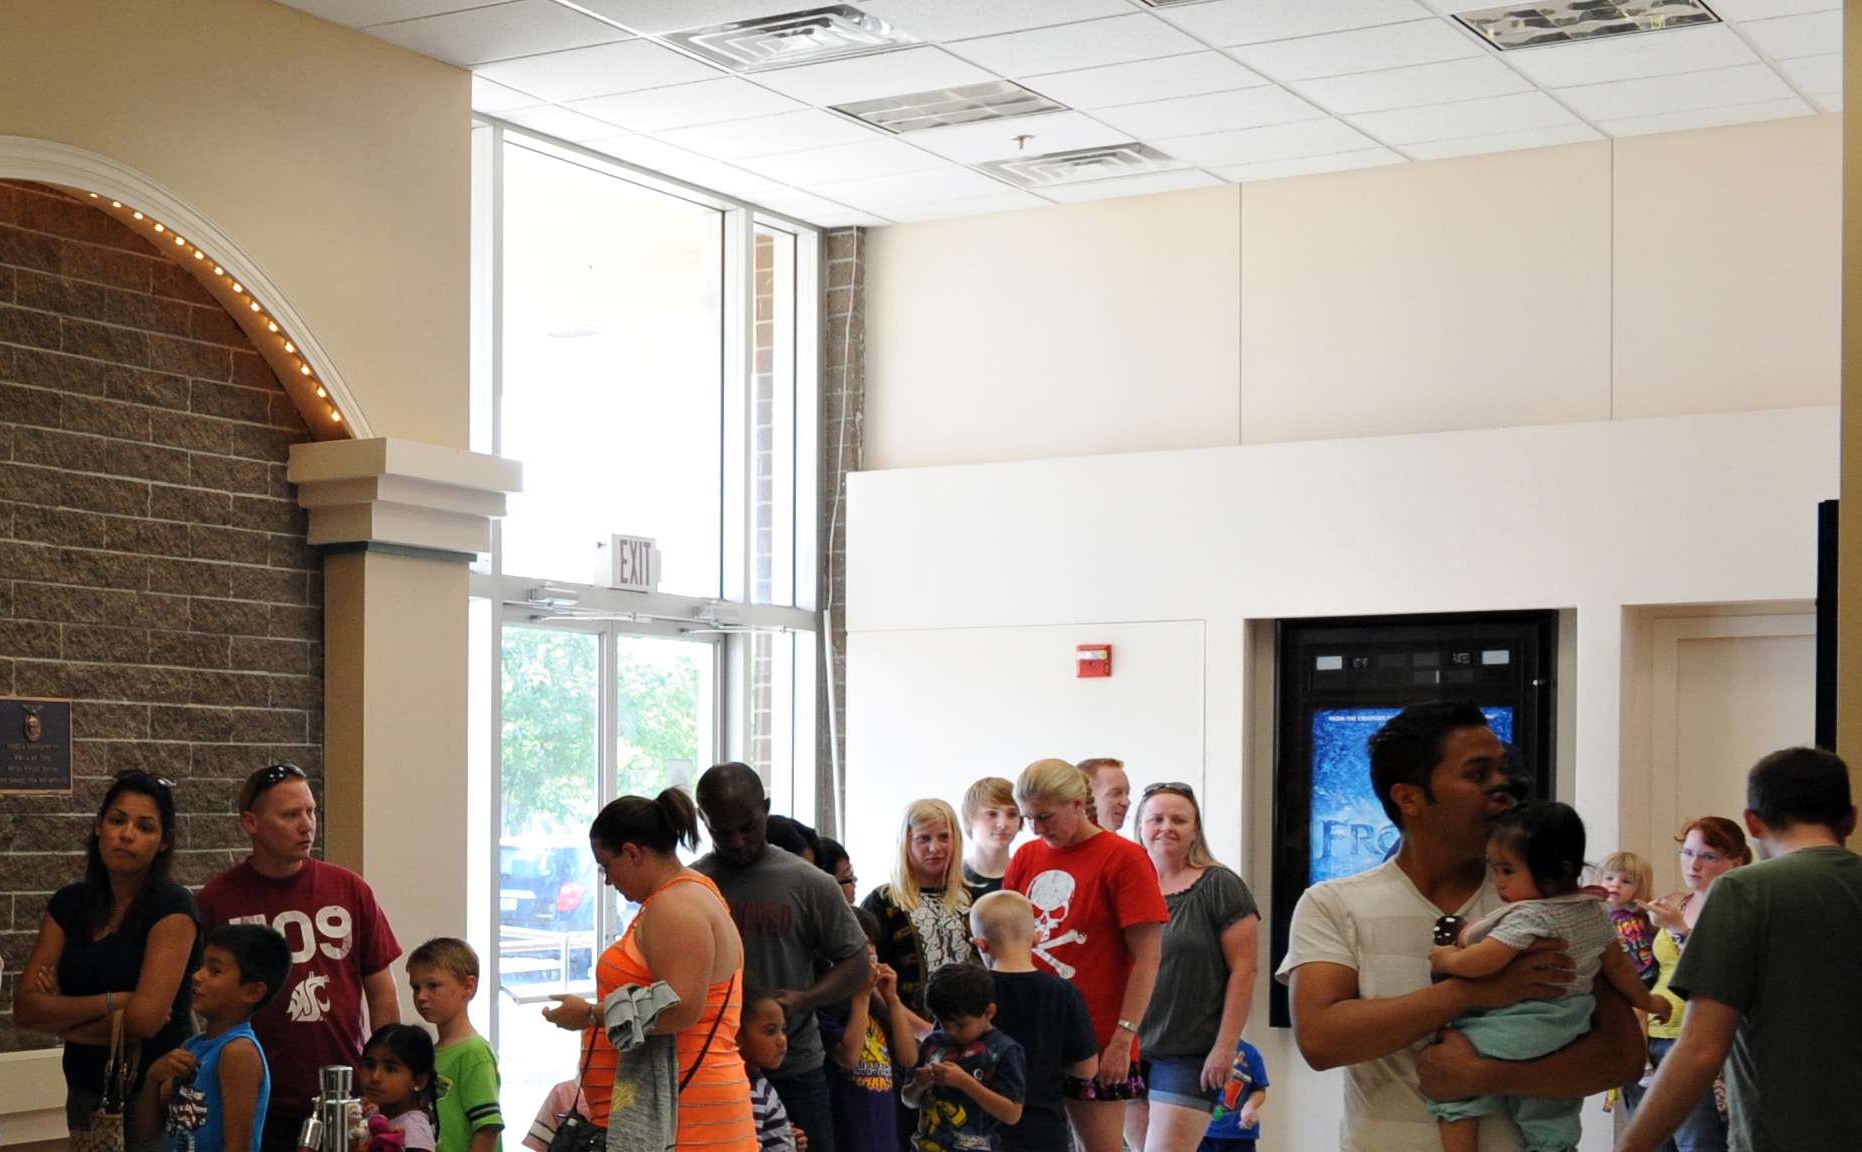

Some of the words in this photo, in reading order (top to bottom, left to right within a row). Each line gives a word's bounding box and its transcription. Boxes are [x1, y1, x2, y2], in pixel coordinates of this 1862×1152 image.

[620, 539, 651, 586] EXIT
[1320, 819, 1401, 859] FRO
[229, 905, 353, 964] 09
